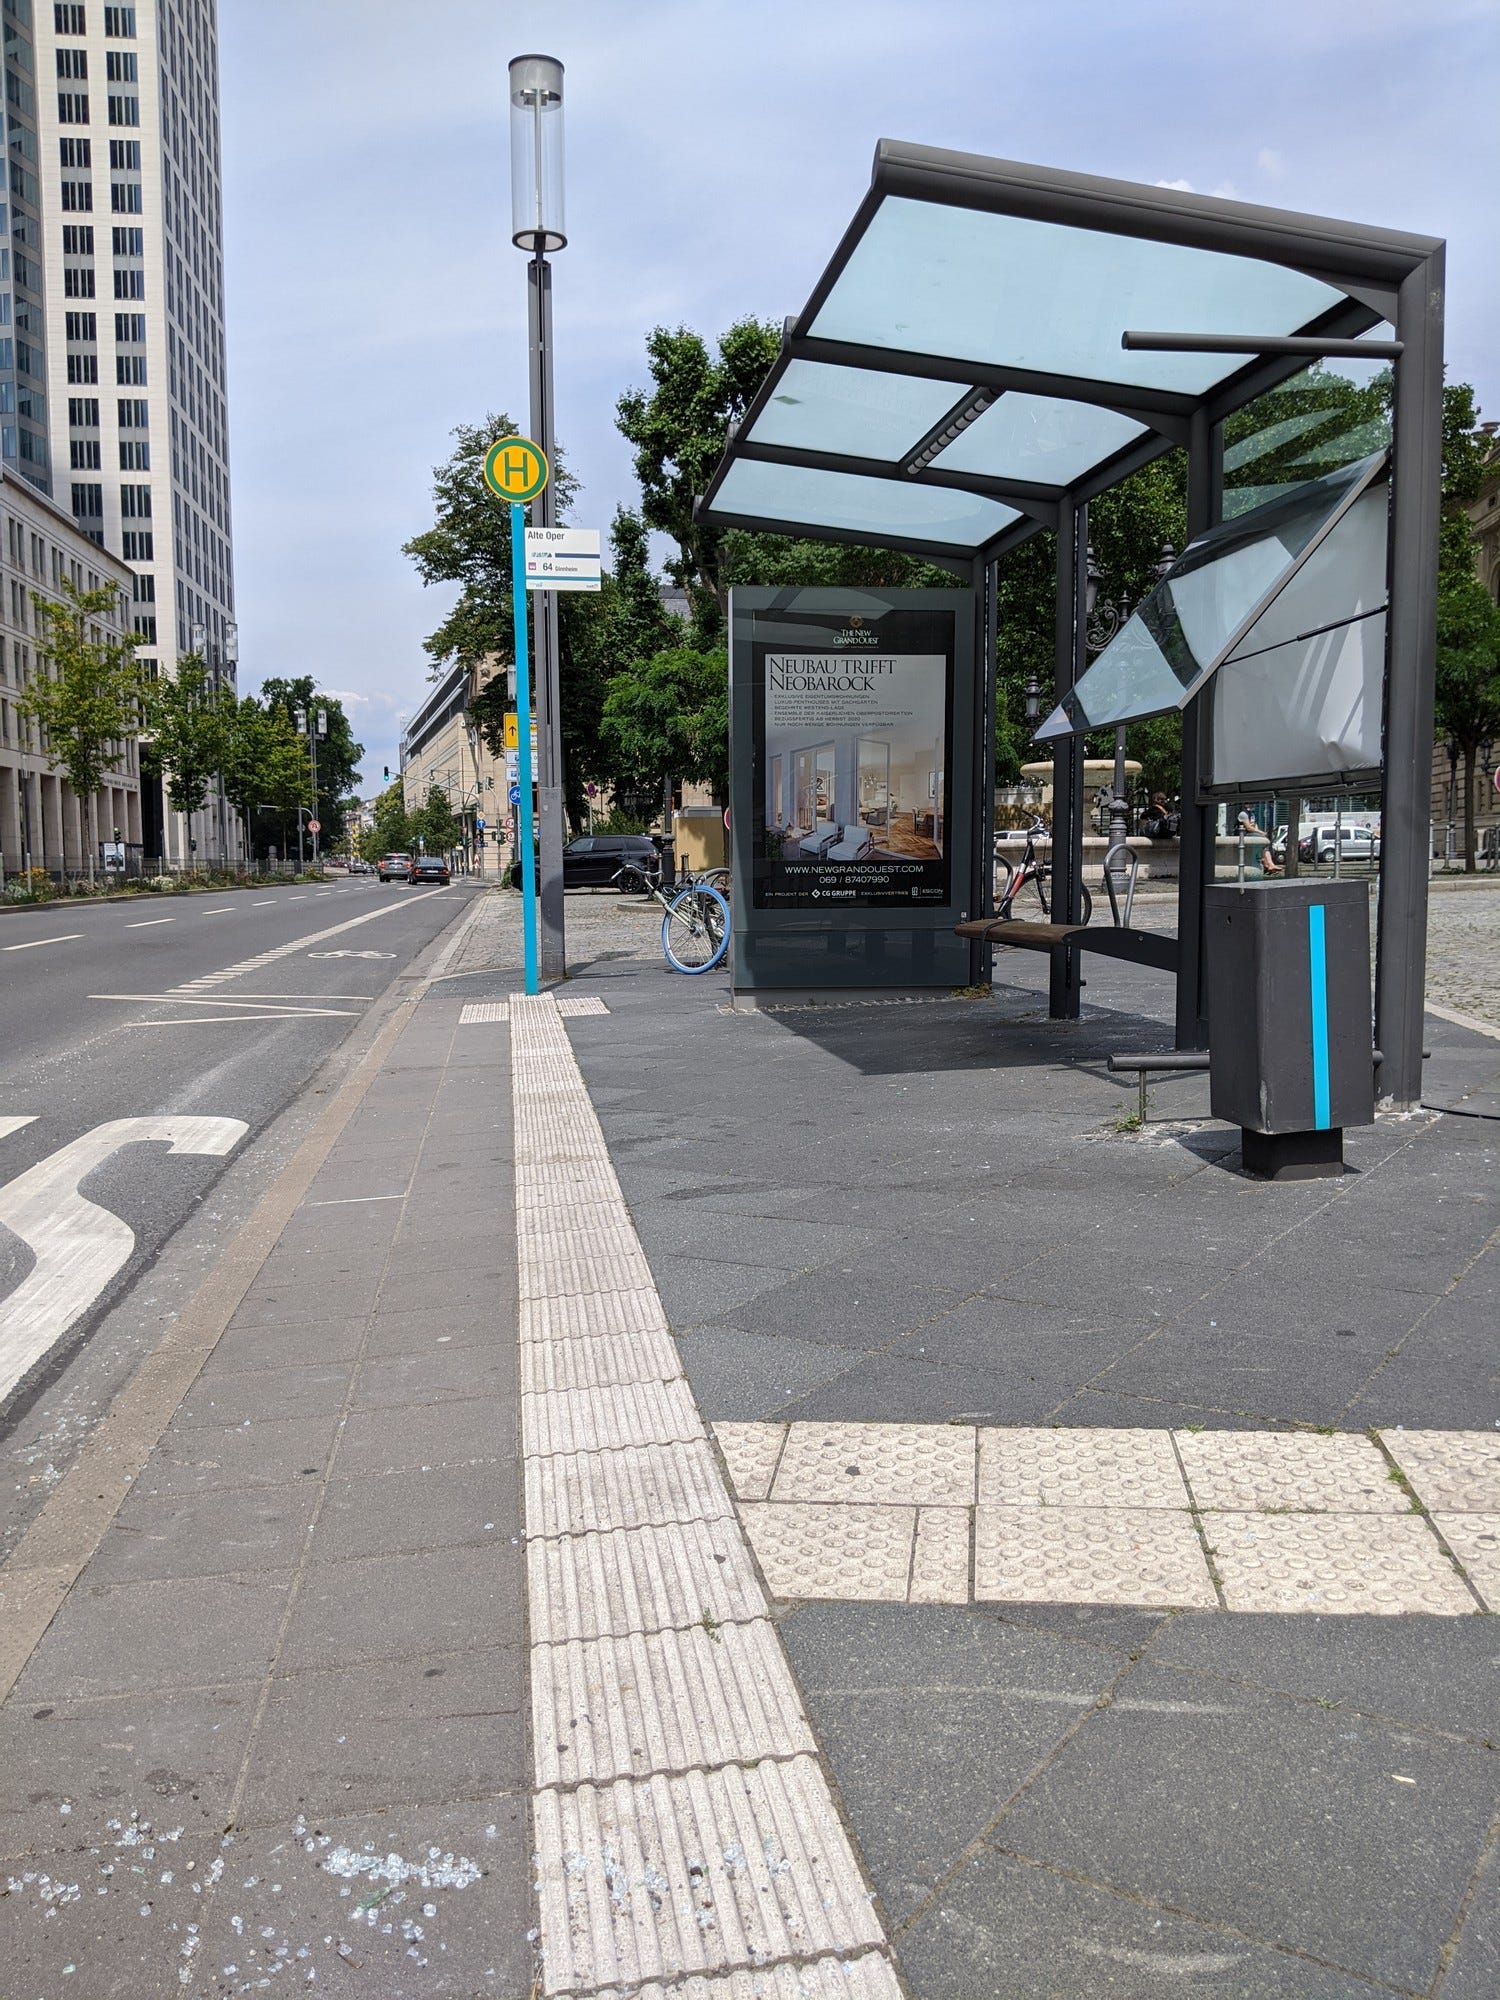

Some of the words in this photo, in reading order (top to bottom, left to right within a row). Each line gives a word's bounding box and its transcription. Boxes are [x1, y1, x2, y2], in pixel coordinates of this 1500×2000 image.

[505, 452, 528, 487] H
[528, 530, 544, 540] Alte
[545, 531, 565, 541] Oper
[542, 562, 553, 571] 64
[841, 629, 854, 637] THE
[855, 629, 872, 637] NEW
[769, 657, 838, 674] NEUBAU
[841, 659, 897, 674] TRIFFT
[769, 674, 876, 691] NEOBAROCK
[784, 865, 924, 874] WWW.NEWGRANDOUEST.COM
[819, 876, 837, 884] 069
[845, 875, 890, 884] 87407990
[831, 889, 857, 897] GRUPPE
